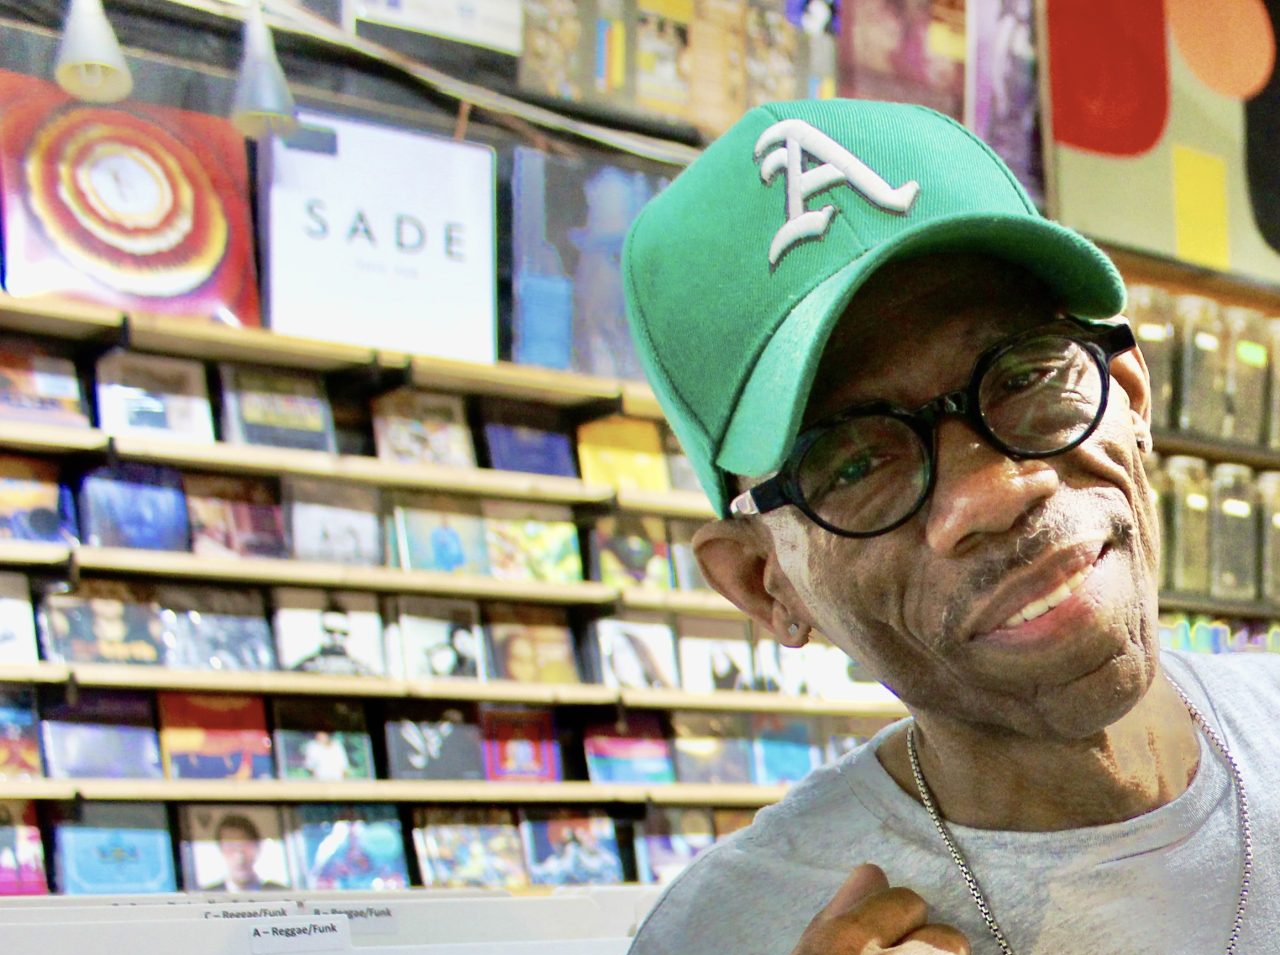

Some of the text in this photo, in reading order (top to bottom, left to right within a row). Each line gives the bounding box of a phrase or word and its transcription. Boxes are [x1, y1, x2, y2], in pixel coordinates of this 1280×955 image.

[305, 197, 466, 263] SADE
[753, 118, 922, 276] A
[252, 927, 262, 938] A
[271, 923, 338, 939] Reggae/Funk
